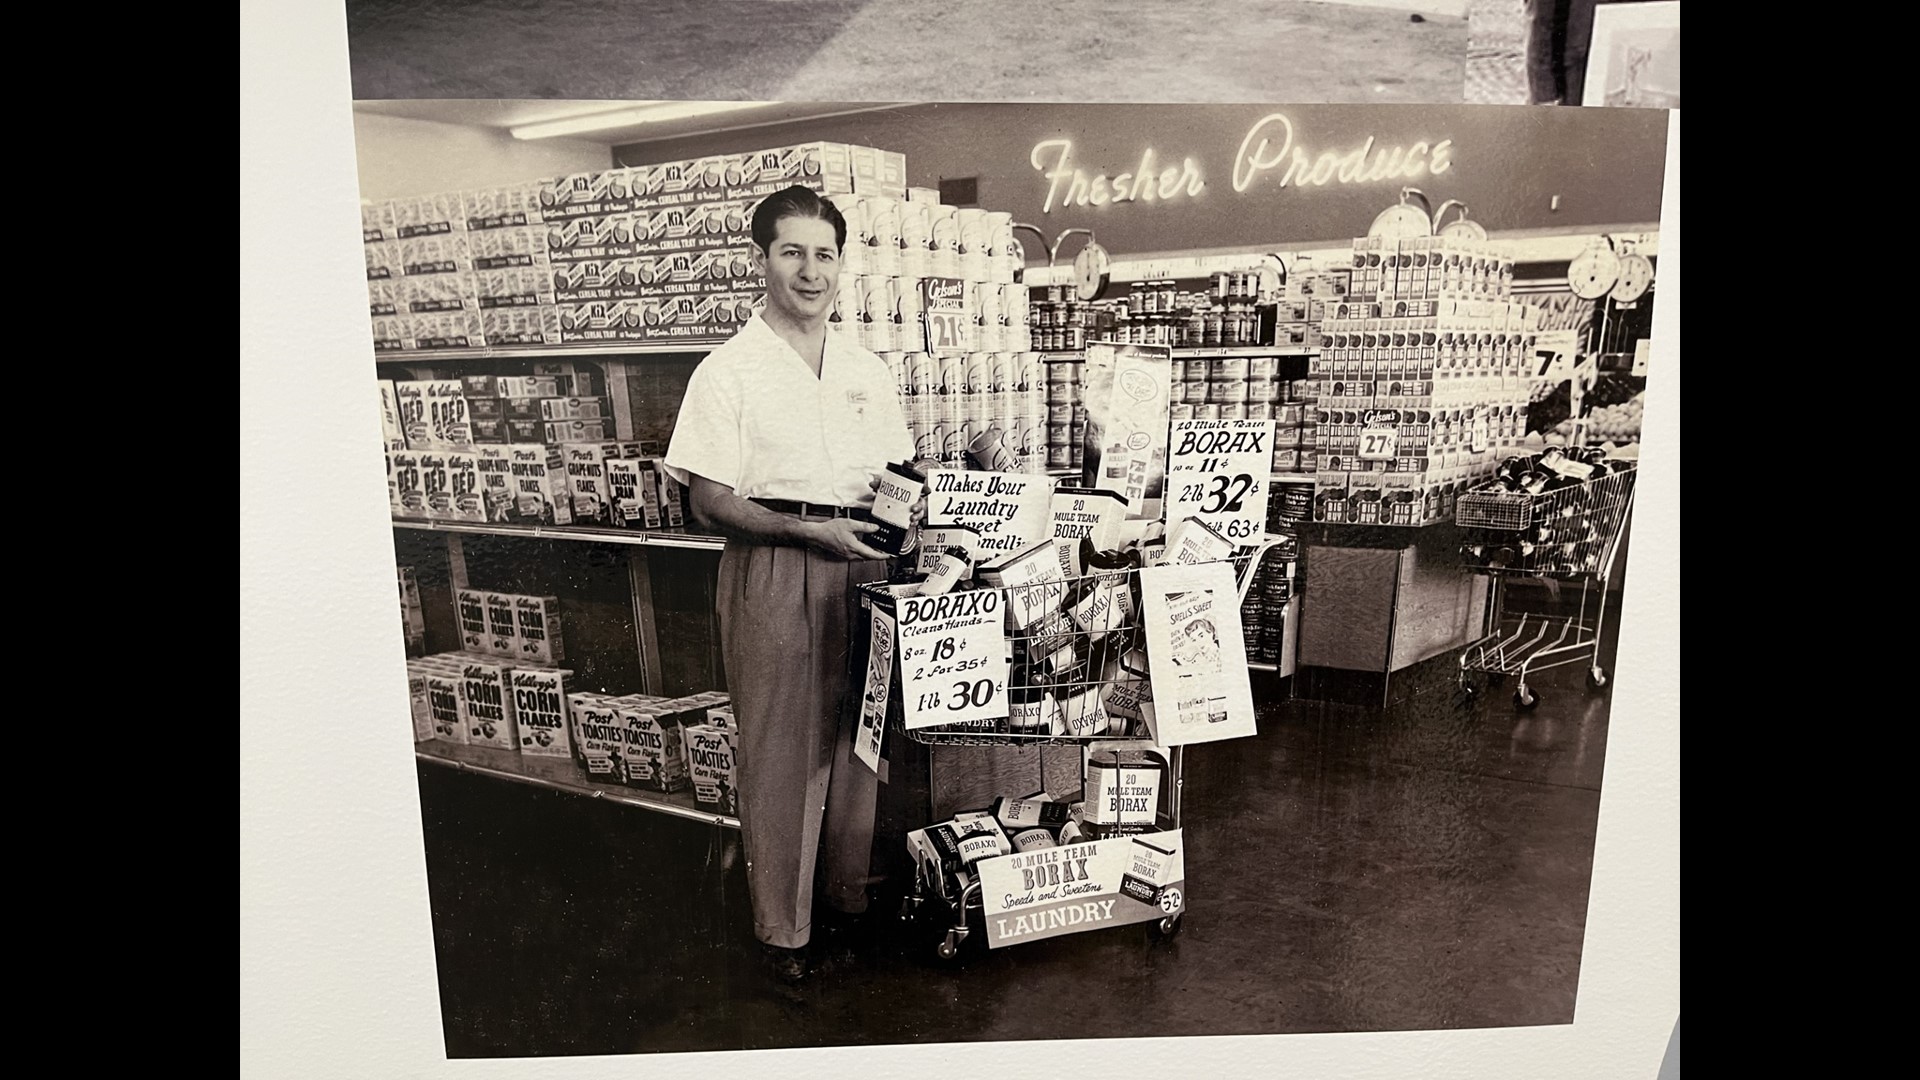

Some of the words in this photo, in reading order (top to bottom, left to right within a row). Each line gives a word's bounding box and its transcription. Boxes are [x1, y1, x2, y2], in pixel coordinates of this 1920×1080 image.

[1031, 139, 1204, 214] Fresher
[1232, 113, 1452, 191] Produce
[929, 279, 963, 299] Gelson's
[403, 400, 424, 425] PEP
[441, 400, 464, 427] PEP
[1364, 410, 1396, 423] Gelson's
[1176, 421, 1191, 431] 20
[1195, 421, 1228, 429] Mule
[1175, 431, 1266, 456] BORAX
[397, 469, 419, 494] PEP
[424, 469, 446, 495] PEP
[452, 471, 475, 496] PEP
[485, 474, 505, 487] FLAKES
[519, 480, 540, 493] FLAKES
[576, 479, 596, 493] FLAKES
[610, 472, 638, 486] RAISIN
[935, 473, 983, 493] Makes
[984, 476, 1026, 497] Your
[615, 486, 635, 499] BRAN
[880, 481, 911, 503] BORAXO
[940, 497, 1019, 520] Laundry
[1073, 500, 1084, 511] 20
[1328, 502, 1342, 512] BIG
[1361, 503, 1376, 512] BIG
[1395, 504, 1410, 513] BIG
[1054, 512, 1077, 522] MULE
[1078, 512, 1100, 523] TEAM
[1327, 512, 1342, 521] BUY
[1361, 513, 1376, 523] BUY
[1394, 514, 1409, 524] BUY
[936, 533, 946, 543] 20
[1054, 524, 1093, 539] BORAX
[923, 545, 939, 553] MULE
[1059, 545, 1072, 576] BORAXO
[1025, 562, 1037, 576] 20
[516, 597, 541, 611] Kellogg's
[899, 592, 997, 625] BORAXO
[460, 603, 483, 622] CORN
[488, 607, 513, 626] CORN
[517, 610, 544, 629] CORN
[1170, 608, 1193, 625] SMELLS
[1193, 600, 1212, 614] SWEET
[463, 621, 485, 634] FLAKES
[490, 624, 515, 637] FLAKES
[520, 627, 545, 641] FLAKES
[903, 624, 943, 638] Cleans
[945, 617, 982, 631] Hands
[904, 648, 913, 661] 8
[463, 665, 499, 684] Kellogg's
[913, 668, 924, 681] 2
[927, 666, 952, 677] for
[428, 679, 454, 694] Kellogg's
[513, 673, 558, 691] Kellogg's
[430, 690, 457, 711] CORN
[465, 680, 503, 706] CORN
[516, 689, 561, 714] CORN
[433, 708, 459, 723] FLAKES
[469, 703, 503, 721] FLAKES
[584, 711, 614, 724] Post
[1011, 707, 1040, 717] ORAXO
[519, 711, 563, 729] FLAKES
[626, 716, 653, 731] Post
[582, 723, 622, 742] TOASTIES
[623, 728, 662, 749] TOASTIES
[586, 741, 601, 750] Corn
[602, 742, 621, 753] Flakes
[693, 735, 722, 750] Post
[627, 747, 641, 756] Corn
[643, 748, 661, 759] Flakes
[690, 748, 731, 770] TOASTIES
[695, 766, 708, 776] Corn
[709, 769, 729, 782] Flakes
[1126, 774, 1136, 785] 20
[1107, 787, 1129, 796] MLE
[1131, 787, 1152, 796] TEAM
[938, 827, 958, 853] LAUNDRY
[964, 840, 997, 853] BORAXO
[1011, 858, 1022, 869] 20
[1026, 851, 1057, 867] MULE
[1064, 845, 1097, 859] TEAM
[1022, 858, 1088, 890] BORAX
[1133, 862, 1156, 878] BORAX
[1002, 891, 1034, 909] Speeds
[1038, 886, 1059, 900] and
[1060, 883, 1104, 897] Sweetens
[1125, 881, 1154, 897] LAUNDRY
[997, 900, 1116, 939] LAUNDRY
